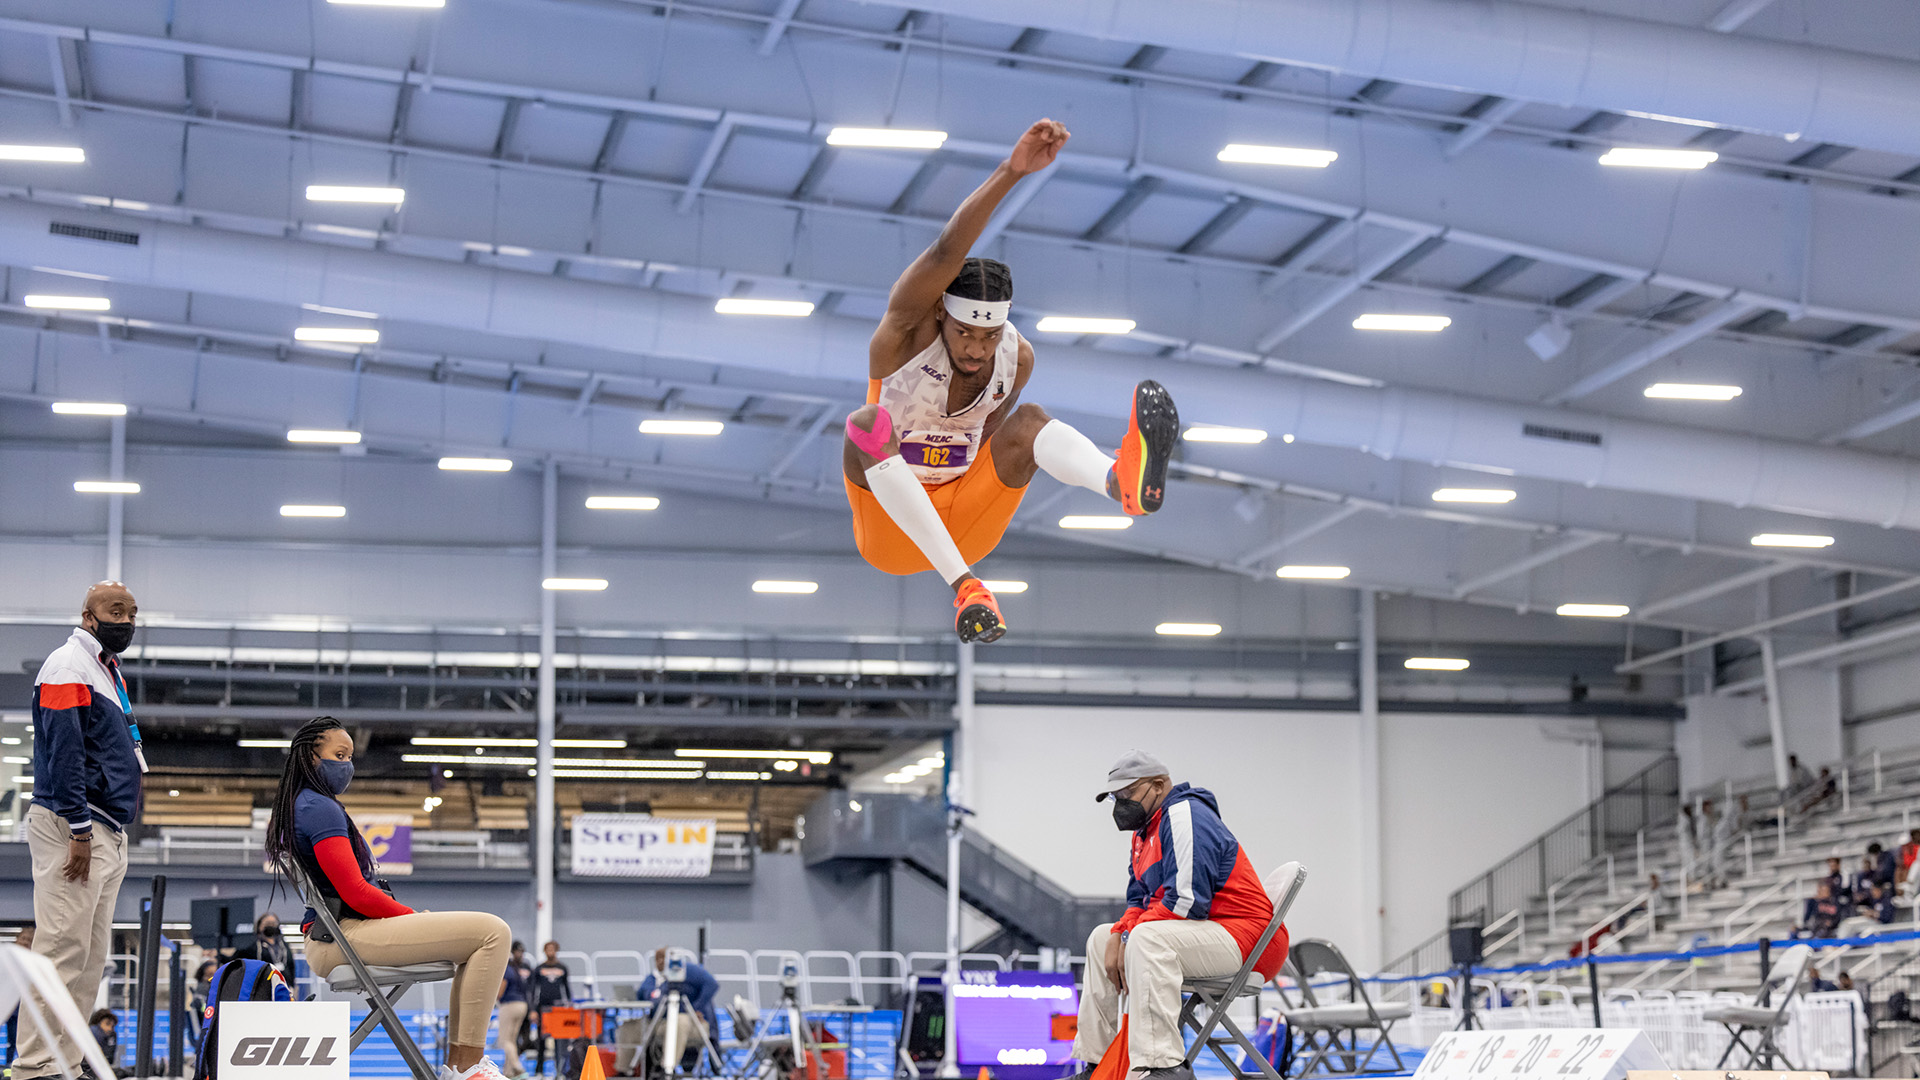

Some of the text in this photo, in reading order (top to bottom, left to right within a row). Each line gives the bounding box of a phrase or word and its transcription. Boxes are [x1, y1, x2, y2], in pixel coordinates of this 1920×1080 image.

[921, 364, 947, 382] MEAC
[924, 434, 953, 443] MEAC
[922, 446, 950, 466] 162
[581, 825, 707, 849] Step IN
[230, 1037, 338, 1066] GILL
[1422, 1034, 1605, 1074] 16 18 20 22
